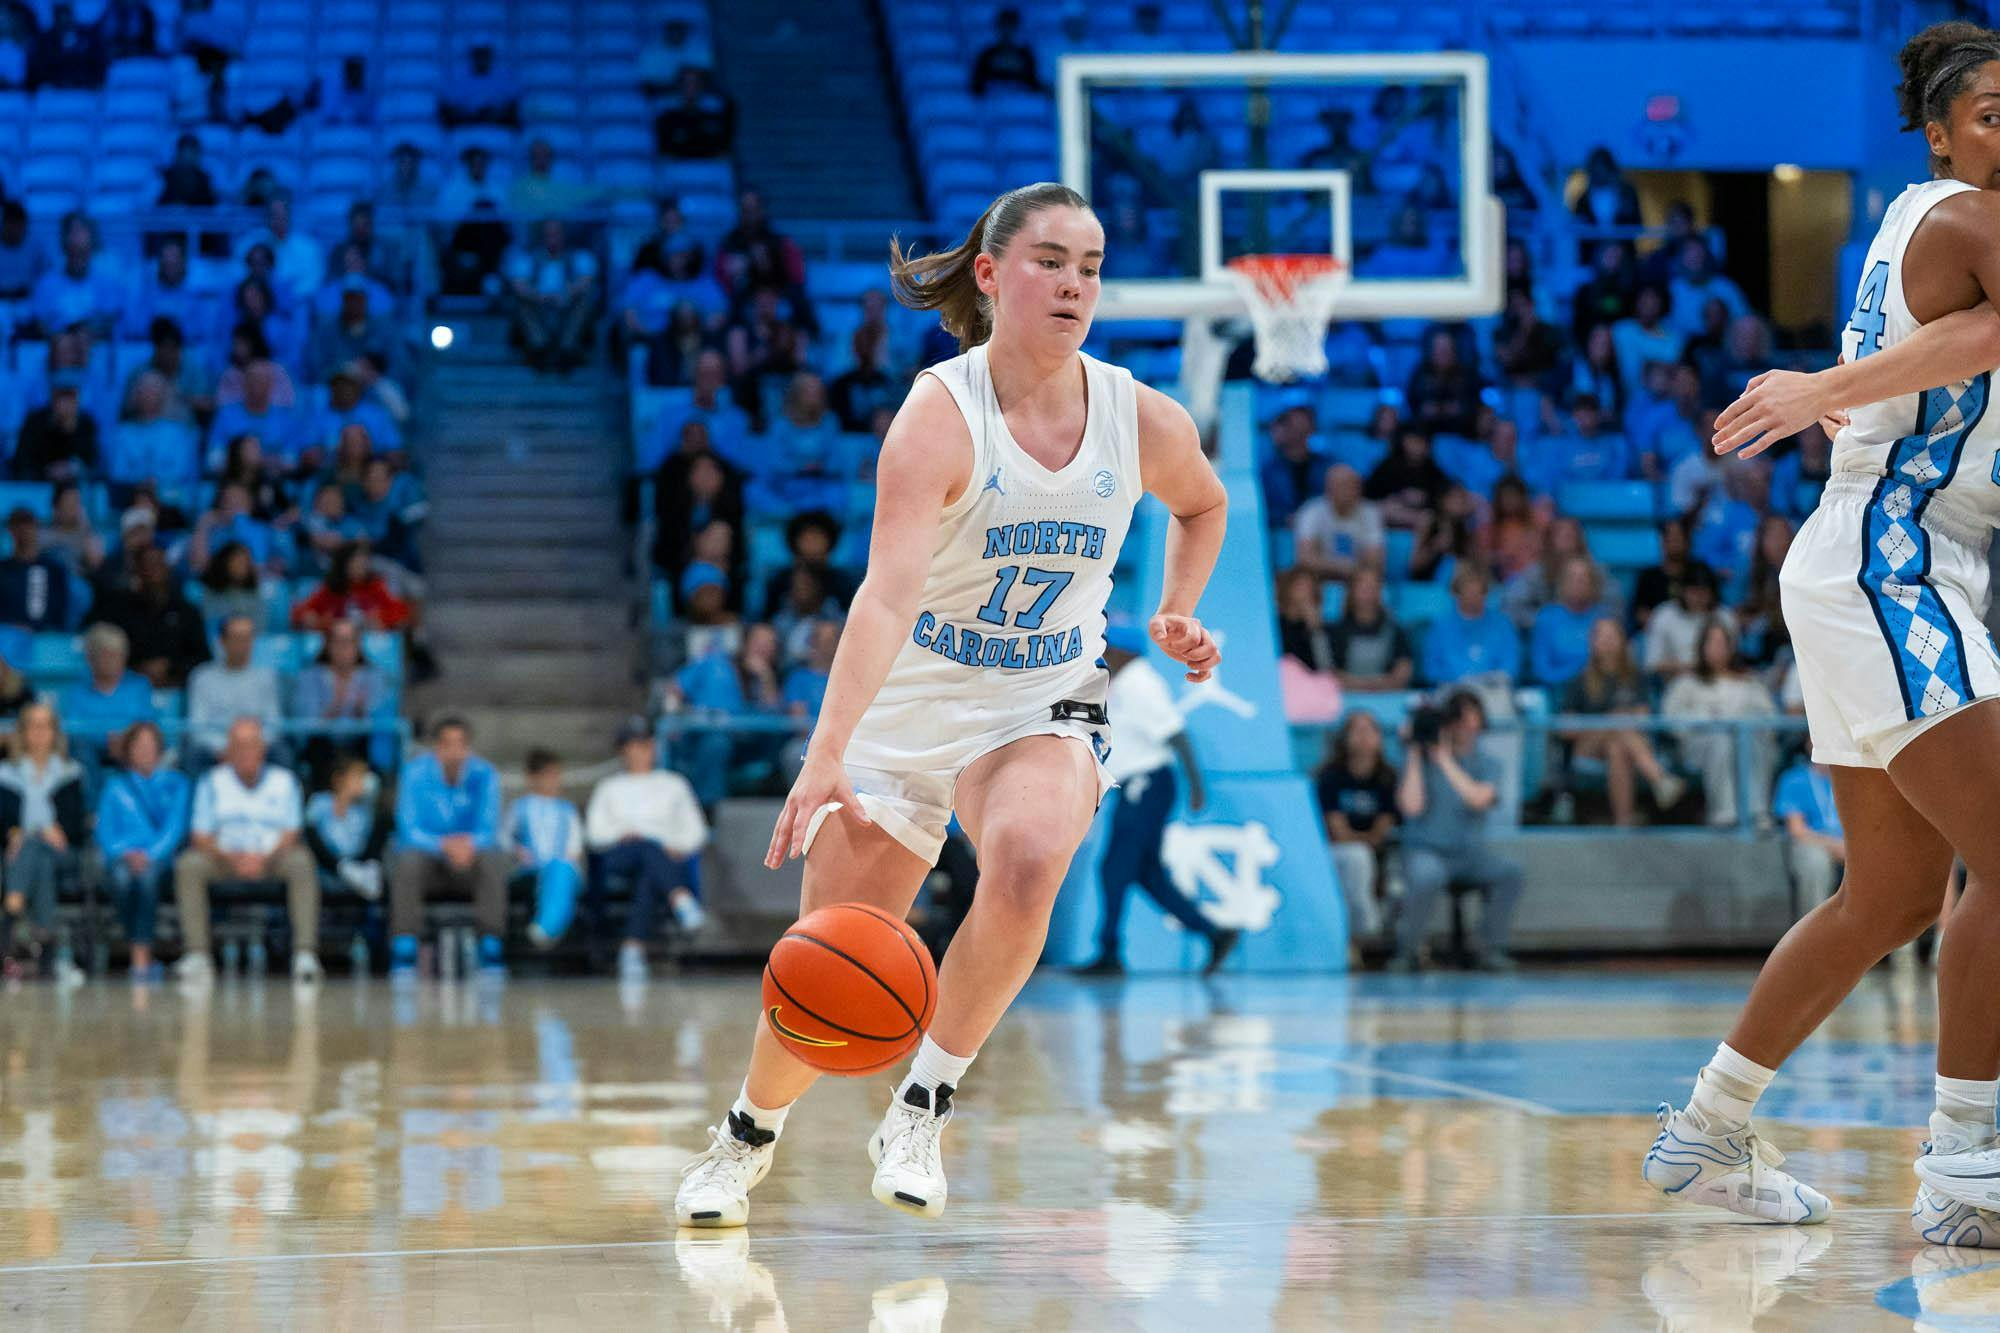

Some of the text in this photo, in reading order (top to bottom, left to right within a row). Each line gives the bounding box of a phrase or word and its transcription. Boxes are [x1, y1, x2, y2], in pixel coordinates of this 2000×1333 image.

[983, 522, 1106, 559] NORTH
[977, 566, 1074, 629] 17
[913, 611, 1082, 668] CAROLINA
